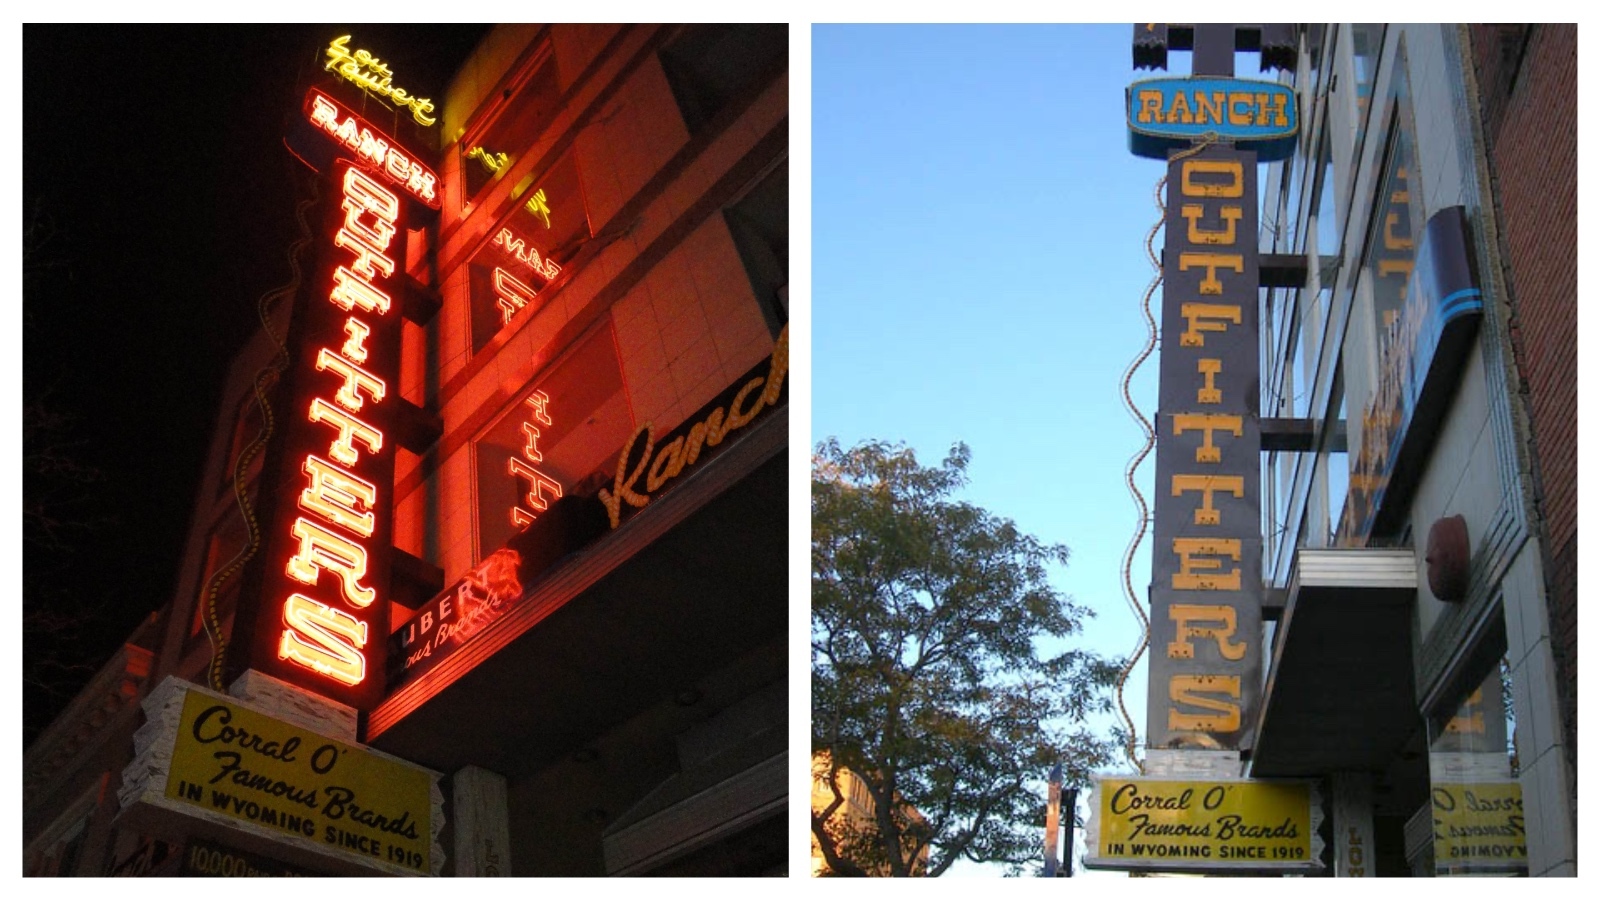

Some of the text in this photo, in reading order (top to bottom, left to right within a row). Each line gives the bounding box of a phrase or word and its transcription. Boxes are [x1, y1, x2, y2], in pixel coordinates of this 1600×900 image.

[311, 94, 436, 204] RANCH
[1136, 89, 1289, 127] RANCH
[278, 166, 400, 687] OUTFITTERS
[1166, 160, 1247, 734] OUTFITTERS
[402, 562, 492, 648] UBERT
[192, 704, 302, 763] Corral
[177, 780, 424, 871] IN WYOMING SINCE 1919
[208, 750, 420, 840] Famous Brands
[1110, 783, 1194, 814] Corral
[1127, 813, 1299, 842] Famous Brands
[1107, 844, 1304, 860] IN WYOMING SINCE 1919
